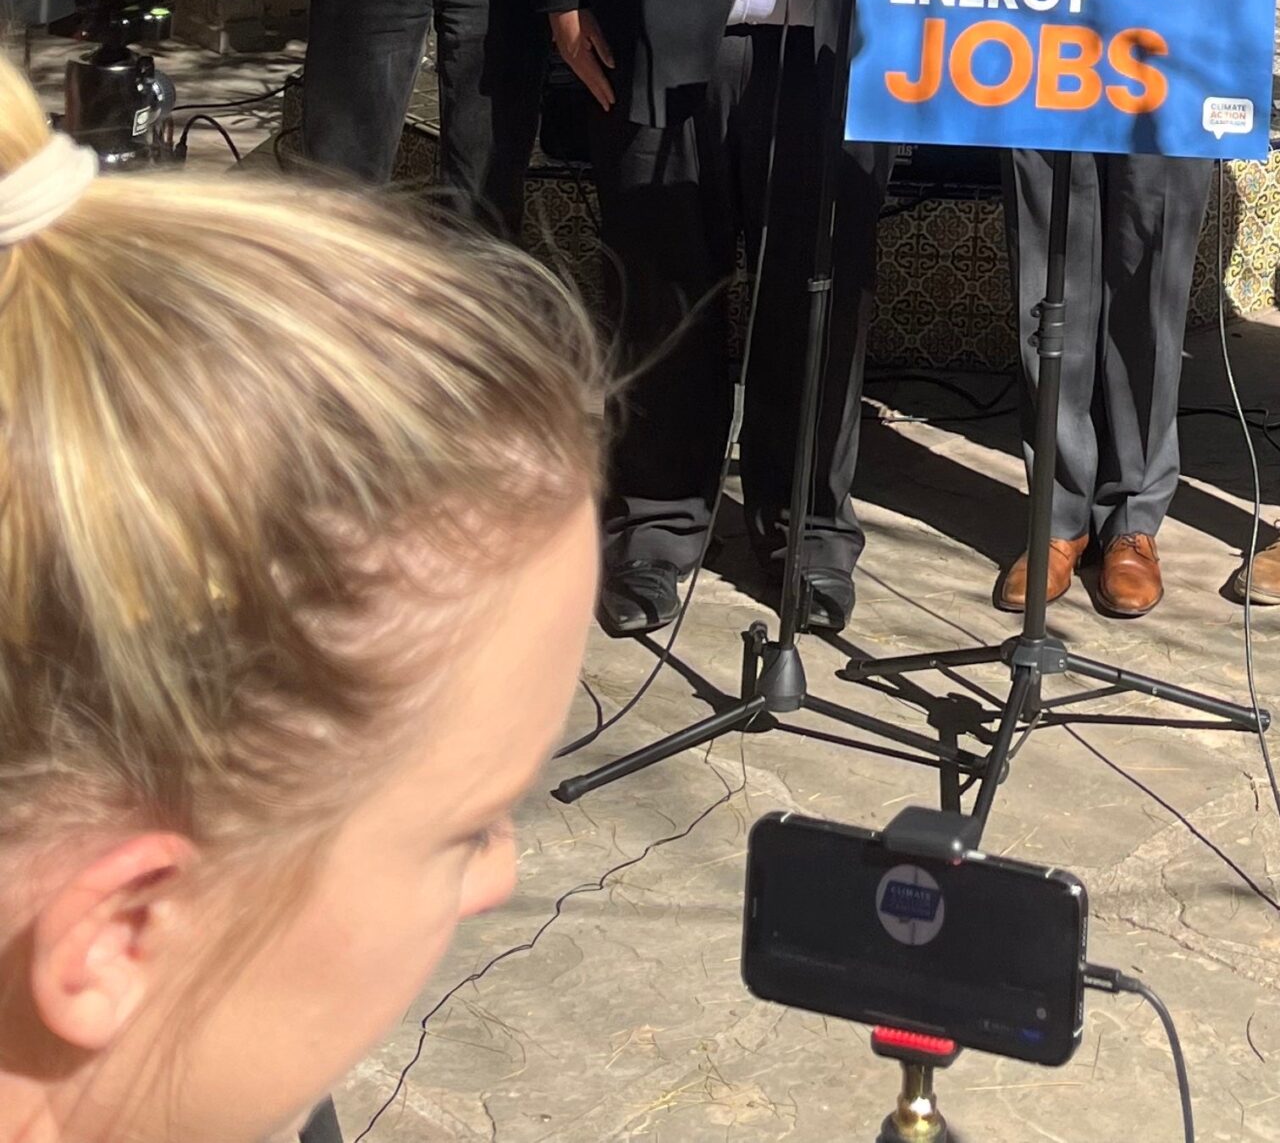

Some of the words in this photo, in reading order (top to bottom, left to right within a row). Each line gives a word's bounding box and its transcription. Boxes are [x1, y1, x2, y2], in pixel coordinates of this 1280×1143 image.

[885, 18, 1169, 115] JOBS
[1210, 103, 1247, 112] CLIMATE
[1210, 111, 1247, 120] ACTION
